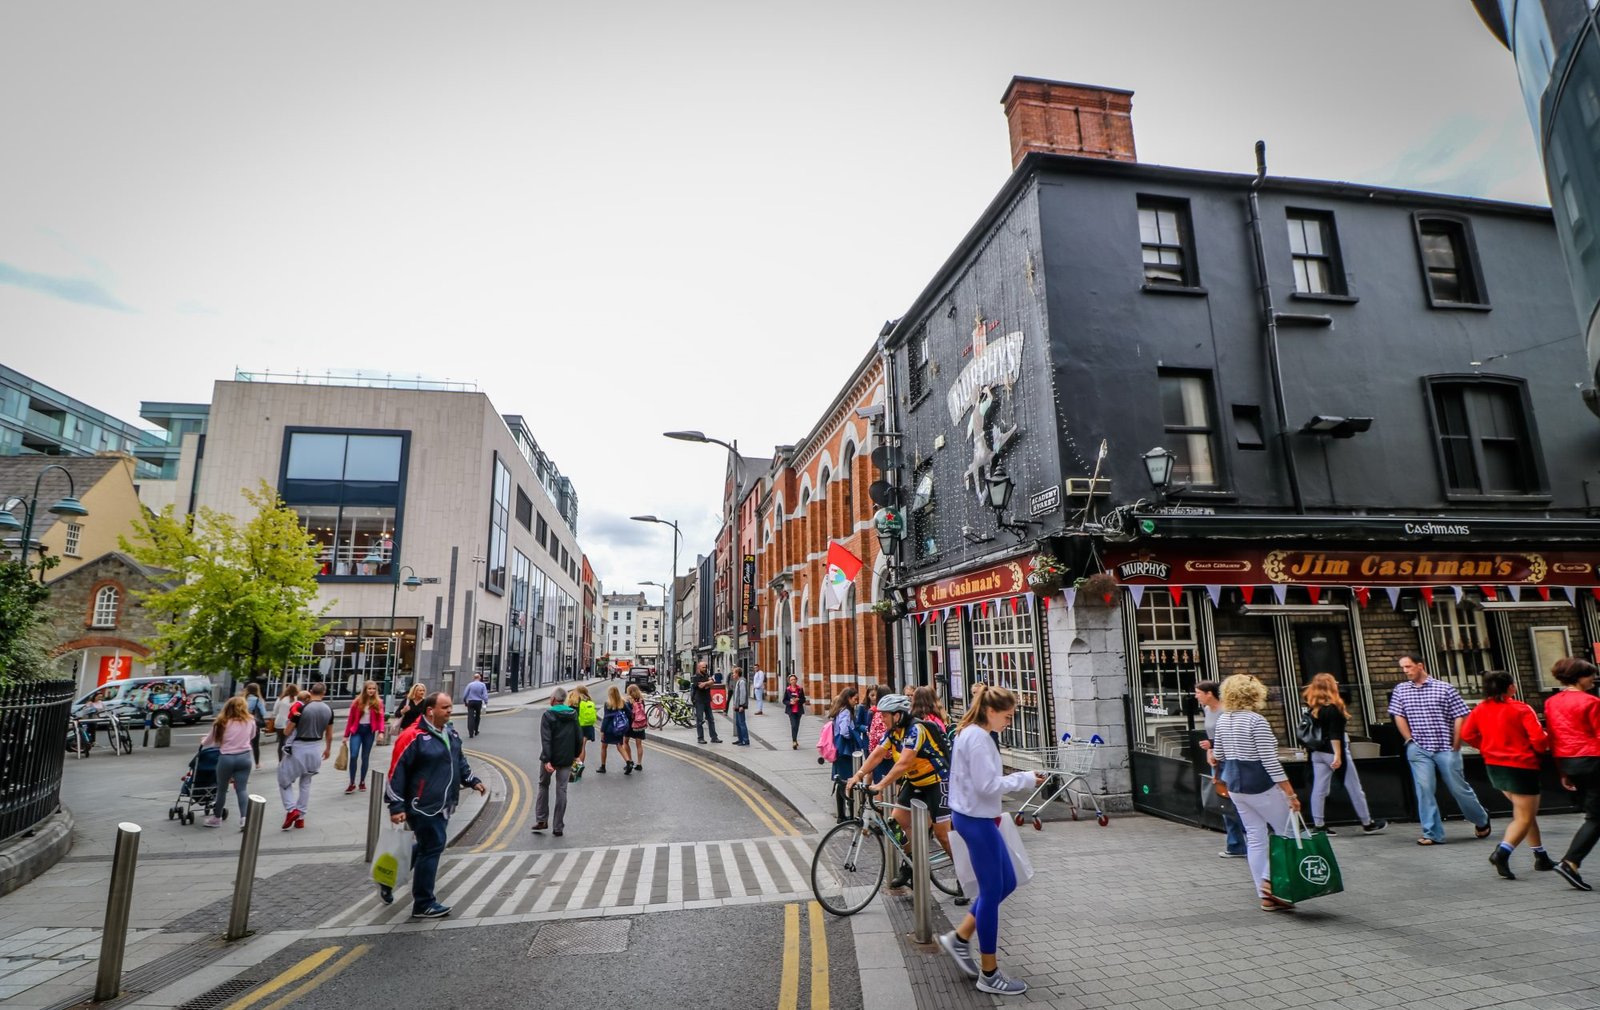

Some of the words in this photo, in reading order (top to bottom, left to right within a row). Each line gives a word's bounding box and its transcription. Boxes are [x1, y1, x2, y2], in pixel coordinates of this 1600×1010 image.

[1032, 489, 1057, 505] ACADEMY
[1033, 497, 1055, 511] STREET
[1405, 522, 1470, 535] Cashmans
[1292, 554, 1349, 575] Jim
[1361, 555, 1512, 576] Cashman's
[932, 586, 947, 601] Jim
[949, 571, 1000, 597] Cashman's
